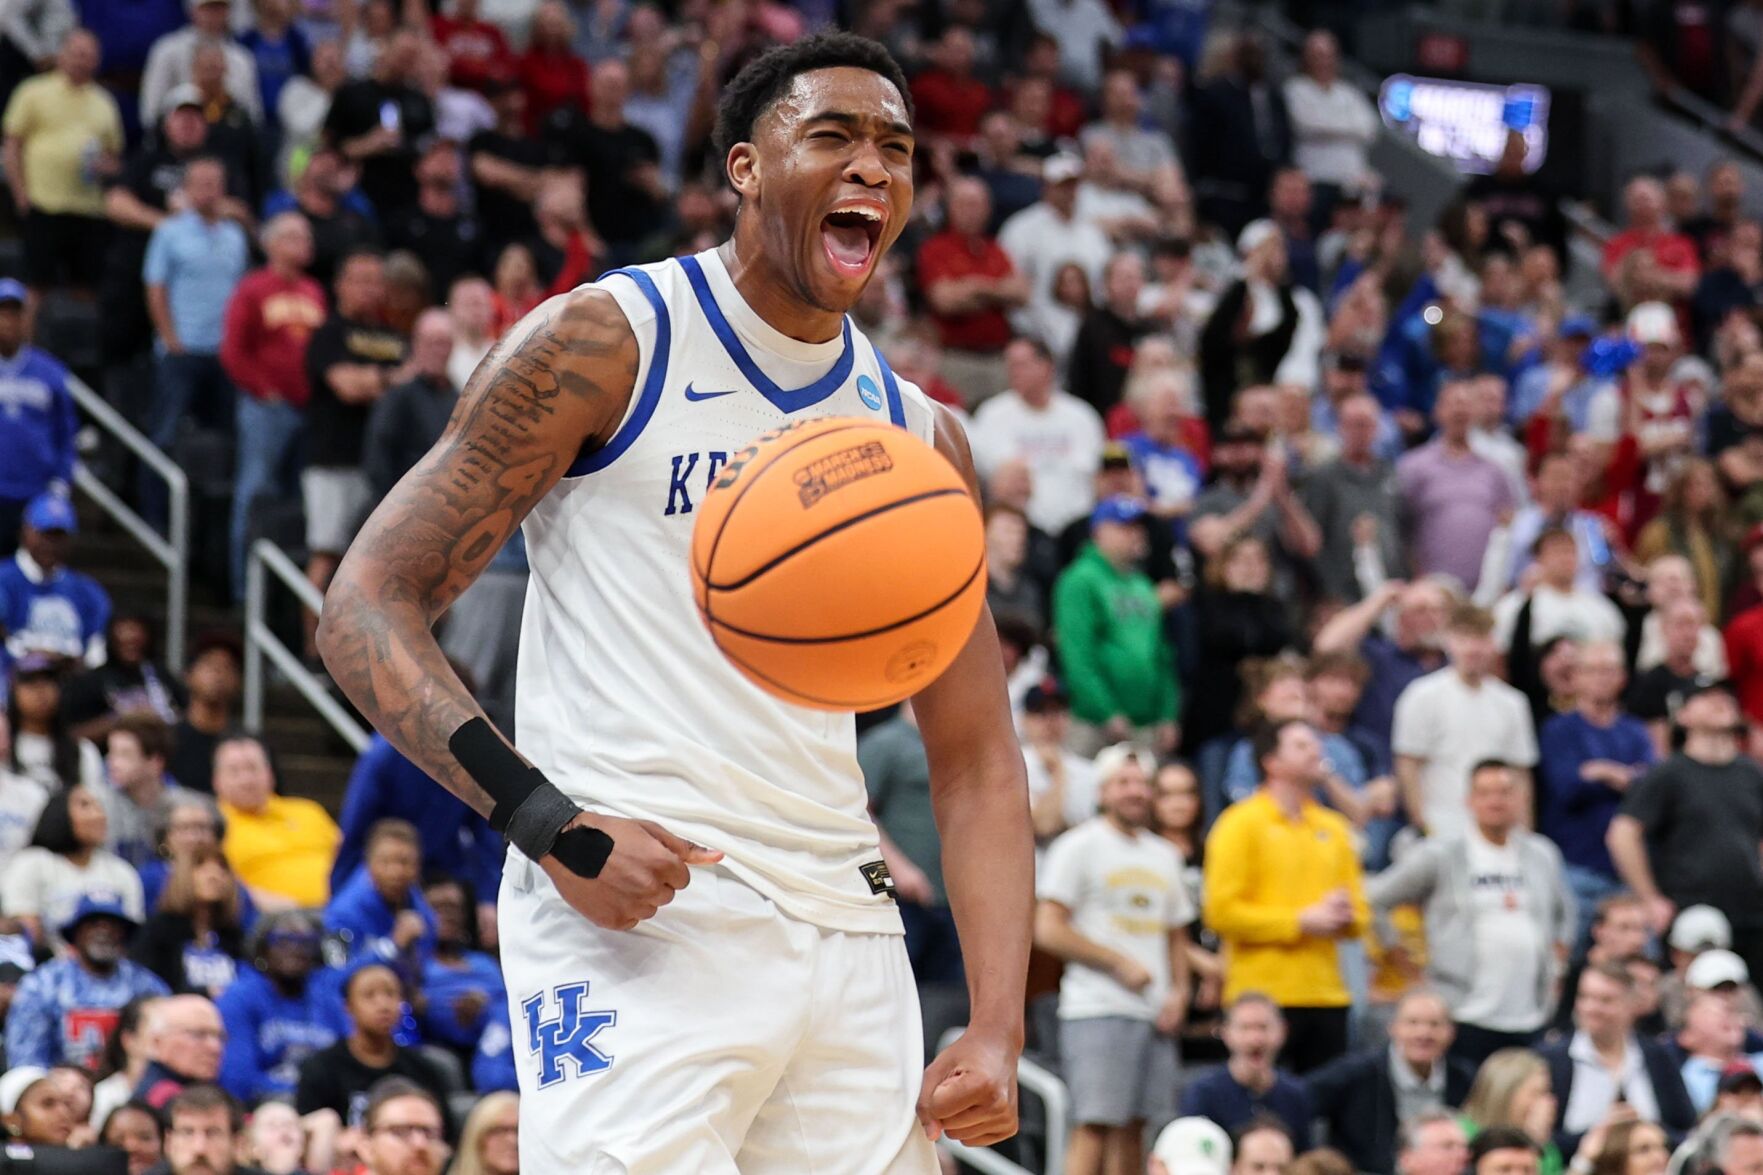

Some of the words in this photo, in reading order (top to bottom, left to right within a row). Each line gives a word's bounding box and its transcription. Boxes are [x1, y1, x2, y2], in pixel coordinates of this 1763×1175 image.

[809, 446, 862, 480] MARCH
[822, 454, 893, 493] MADNESS
[521, 981, 617, 1090] UK
